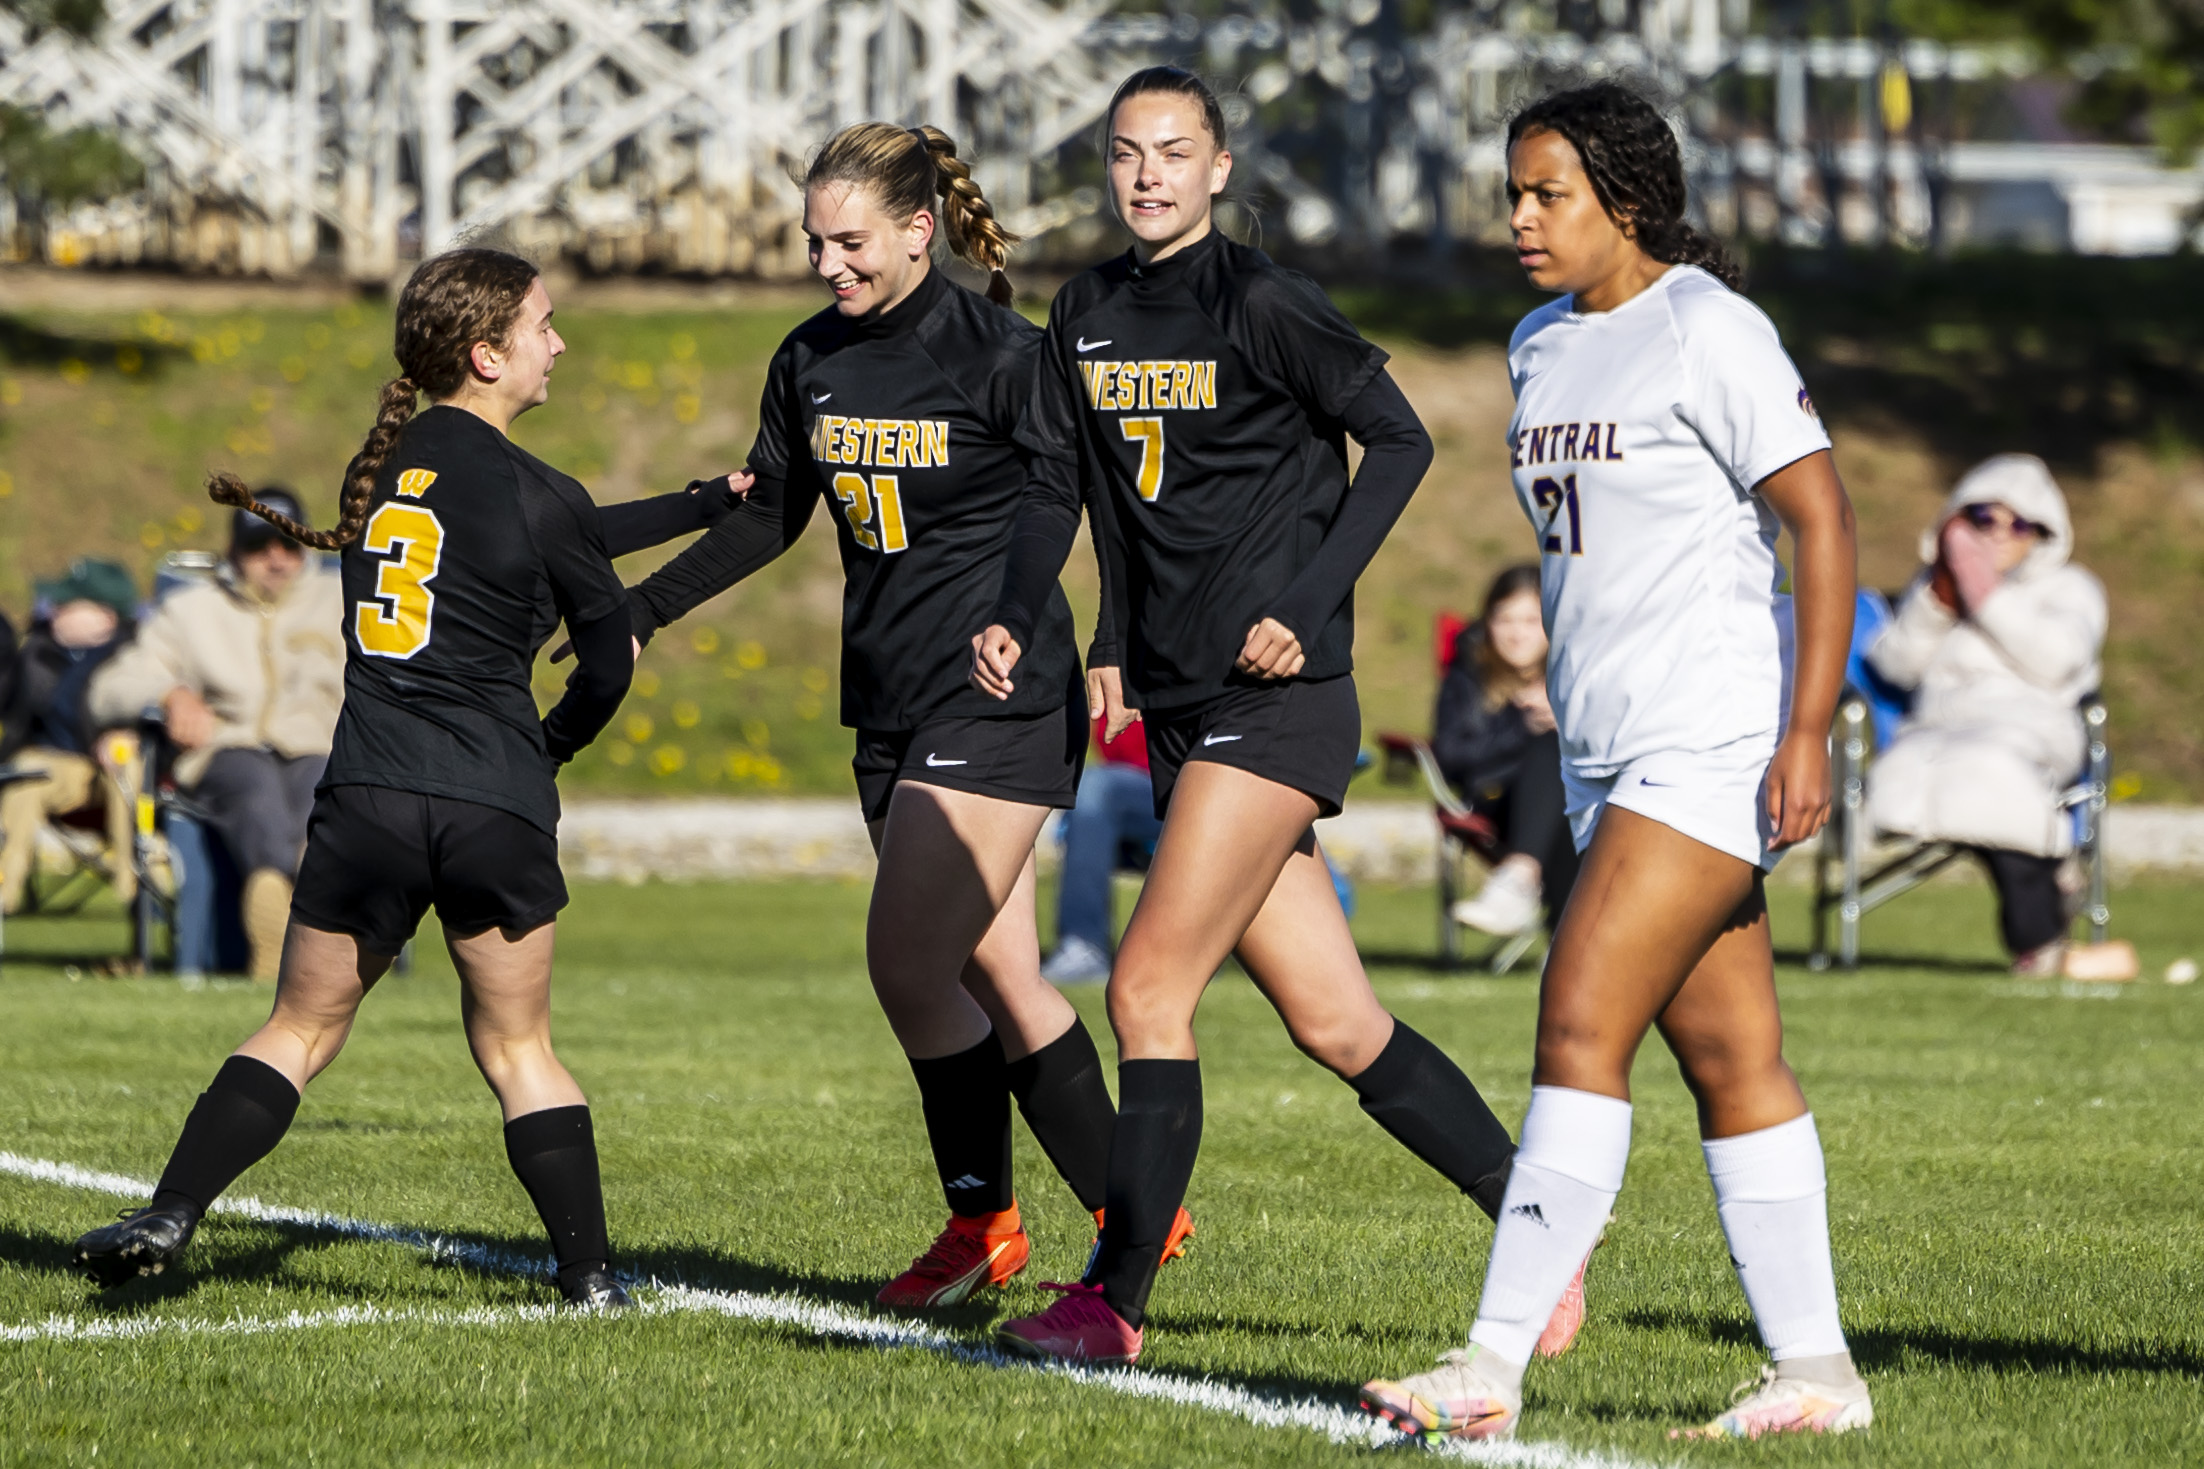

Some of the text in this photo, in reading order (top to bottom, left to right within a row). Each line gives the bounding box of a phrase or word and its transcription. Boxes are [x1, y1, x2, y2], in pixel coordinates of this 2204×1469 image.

[396, 468, 438, 498] W
[1119, 416, 1164, 502] 7
[1511, 422, 1623, 469] ENTRAL
[833, 472, 909, 553] 21
[1531, 473, 1583, 556] 21
[355, 501, 444, 660] 3
